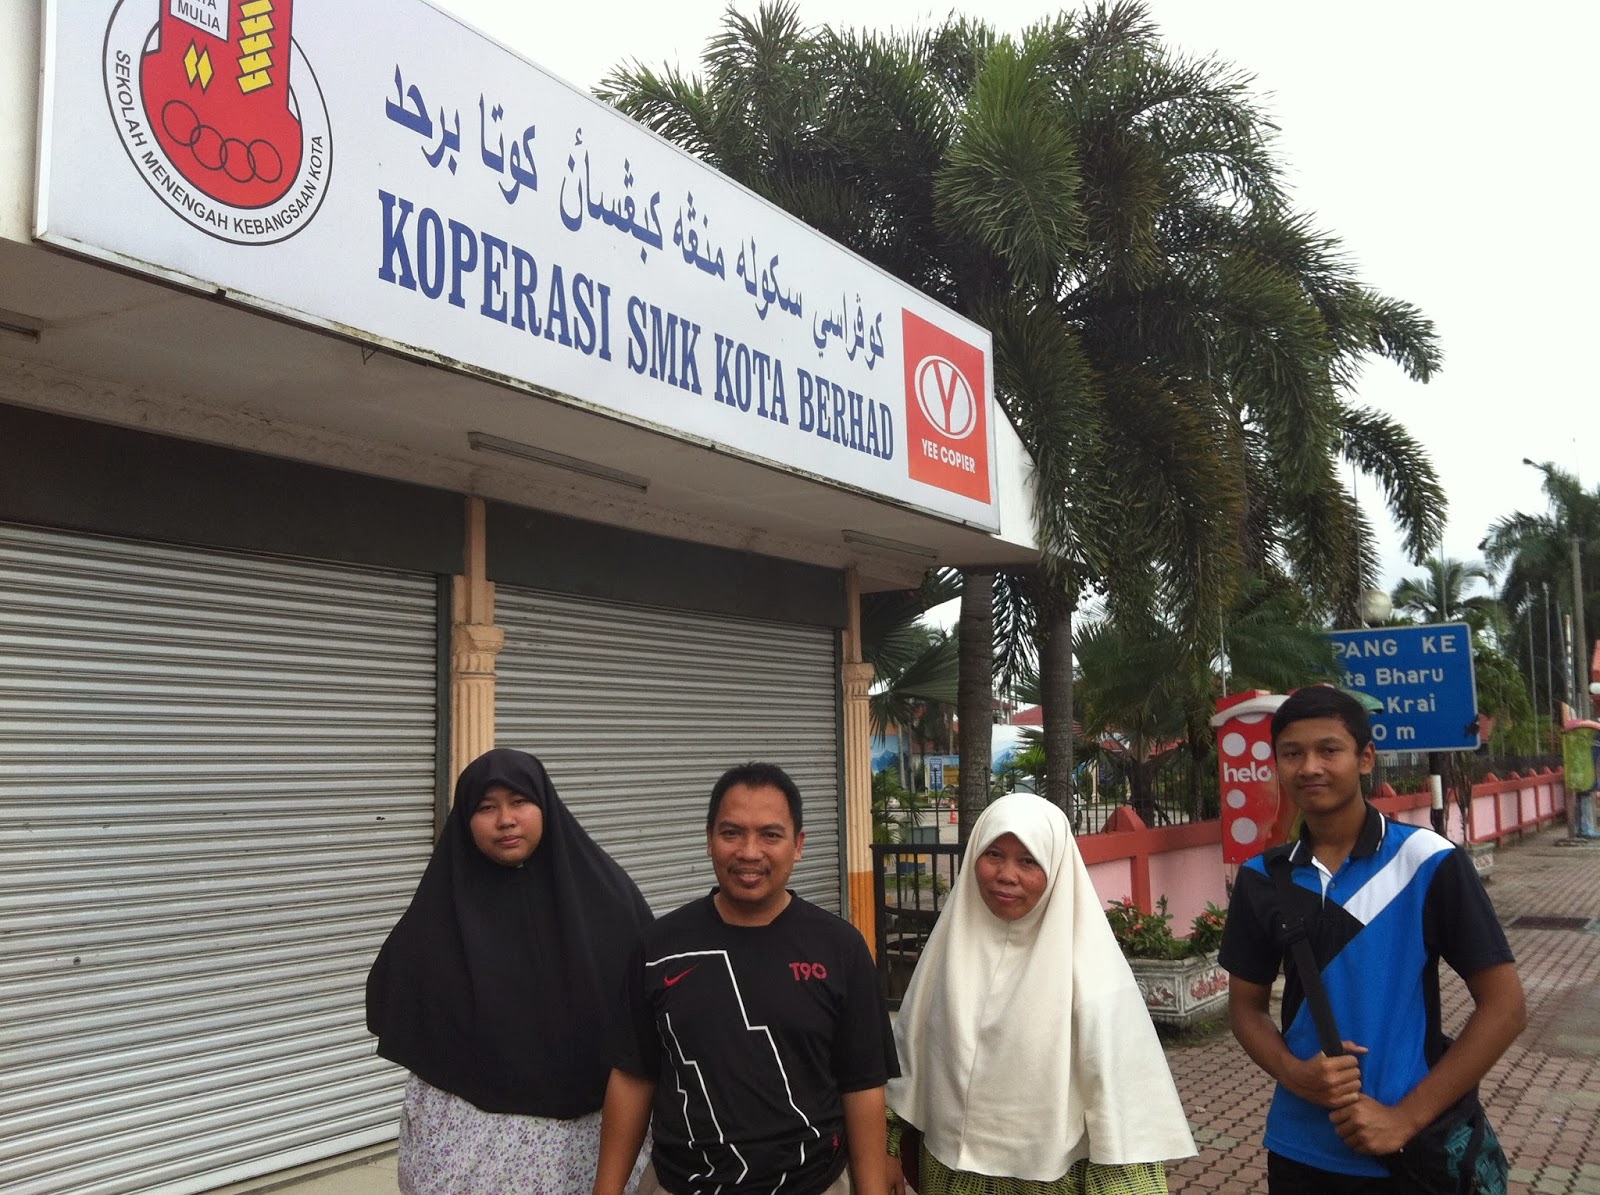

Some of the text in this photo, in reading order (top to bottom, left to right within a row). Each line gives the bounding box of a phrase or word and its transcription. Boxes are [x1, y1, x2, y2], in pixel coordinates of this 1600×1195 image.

[178, 0, 220, 32] MULIA
[115, 49, 323, 235] SEKOLAH MENENGAH KEBANGSAAN KOTA
[378, 188, 895, 461] KOPERASI SMK KOTA BERHAD
[921, 438, 976, 474] YEE COPIER
[1330, 635, 1457, 659] PANG KE
[1346, 667, 1444, 687] ta Bharu
[1387, 693, 1436, 714] Krai
[1396, 725, 1416, 740] m
[1223, 761, 1272, 783] helo
[788, 961, 828, 981] T90
